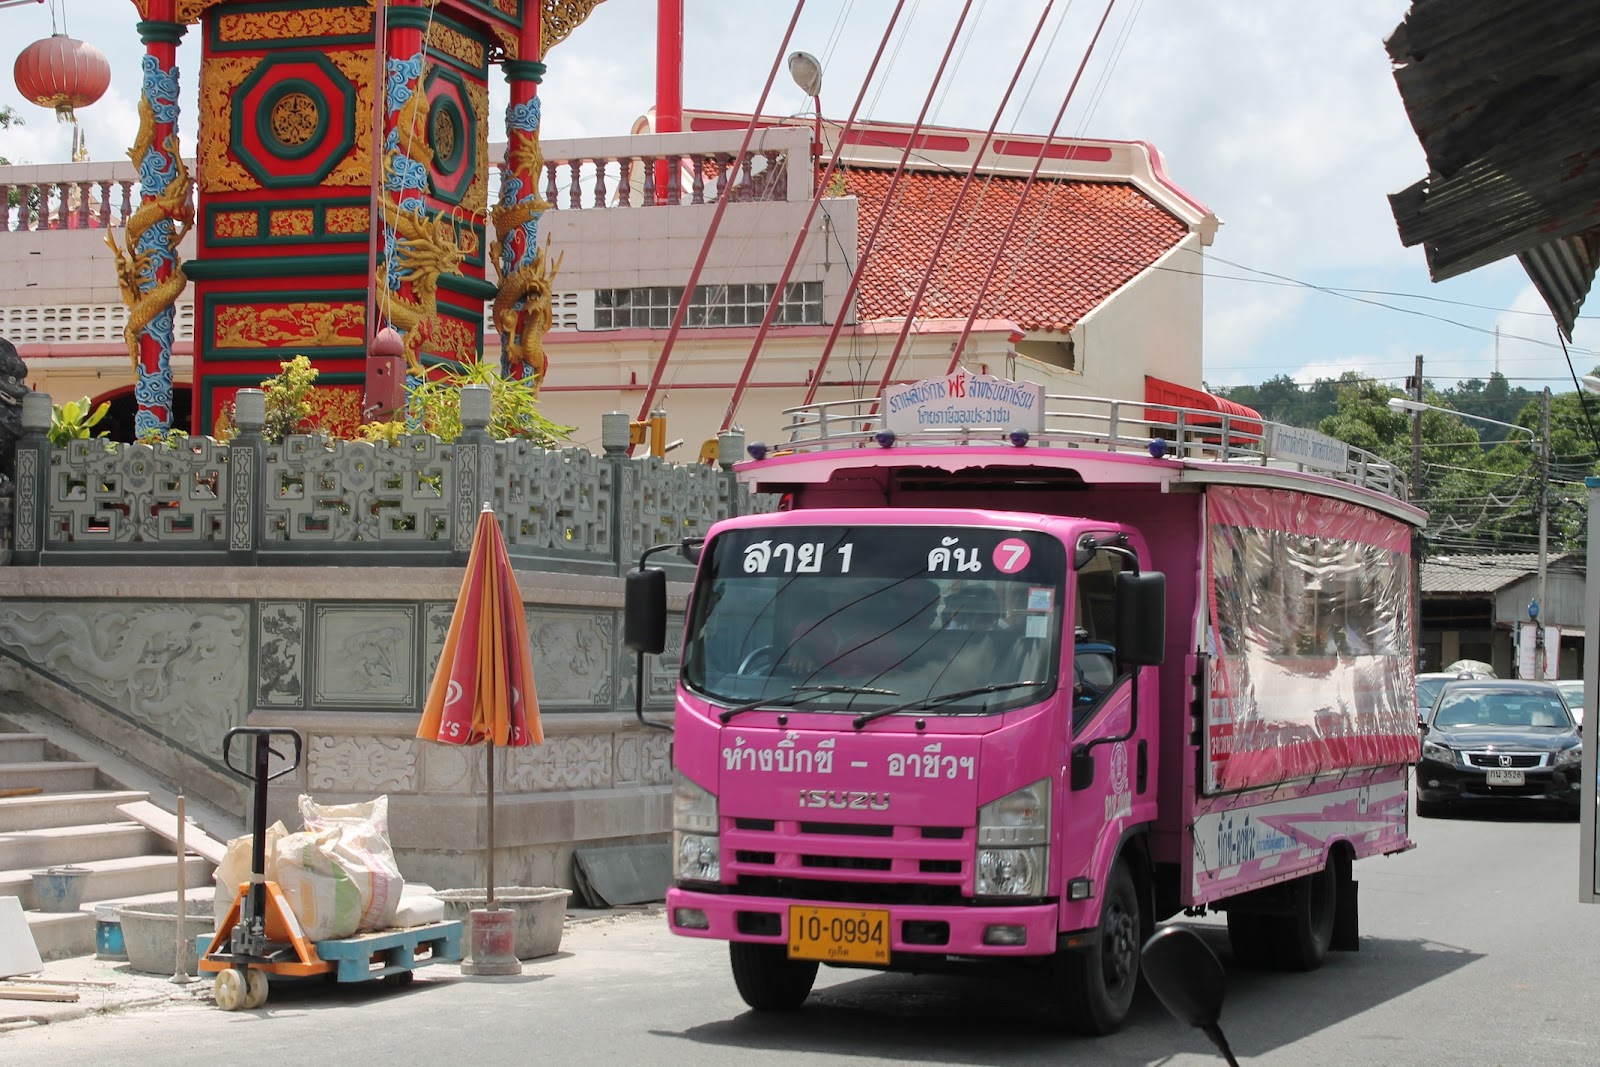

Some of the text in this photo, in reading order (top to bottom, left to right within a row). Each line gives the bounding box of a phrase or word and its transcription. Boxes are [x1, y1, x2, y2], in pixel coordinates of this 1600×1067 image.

[948, 372, 965, 398] ฟรี
[742, 539, 853, 573] สาย 1
[927, 536, 1025, 572] คัน 7
[722, 731, 836, 773] ห้างบิ๊กซี
[886, 742, 975, 780] อาชีวฯ
[799, 789, 891, 811] ISUZU
[799, 915, 883, 945] 10-0994
